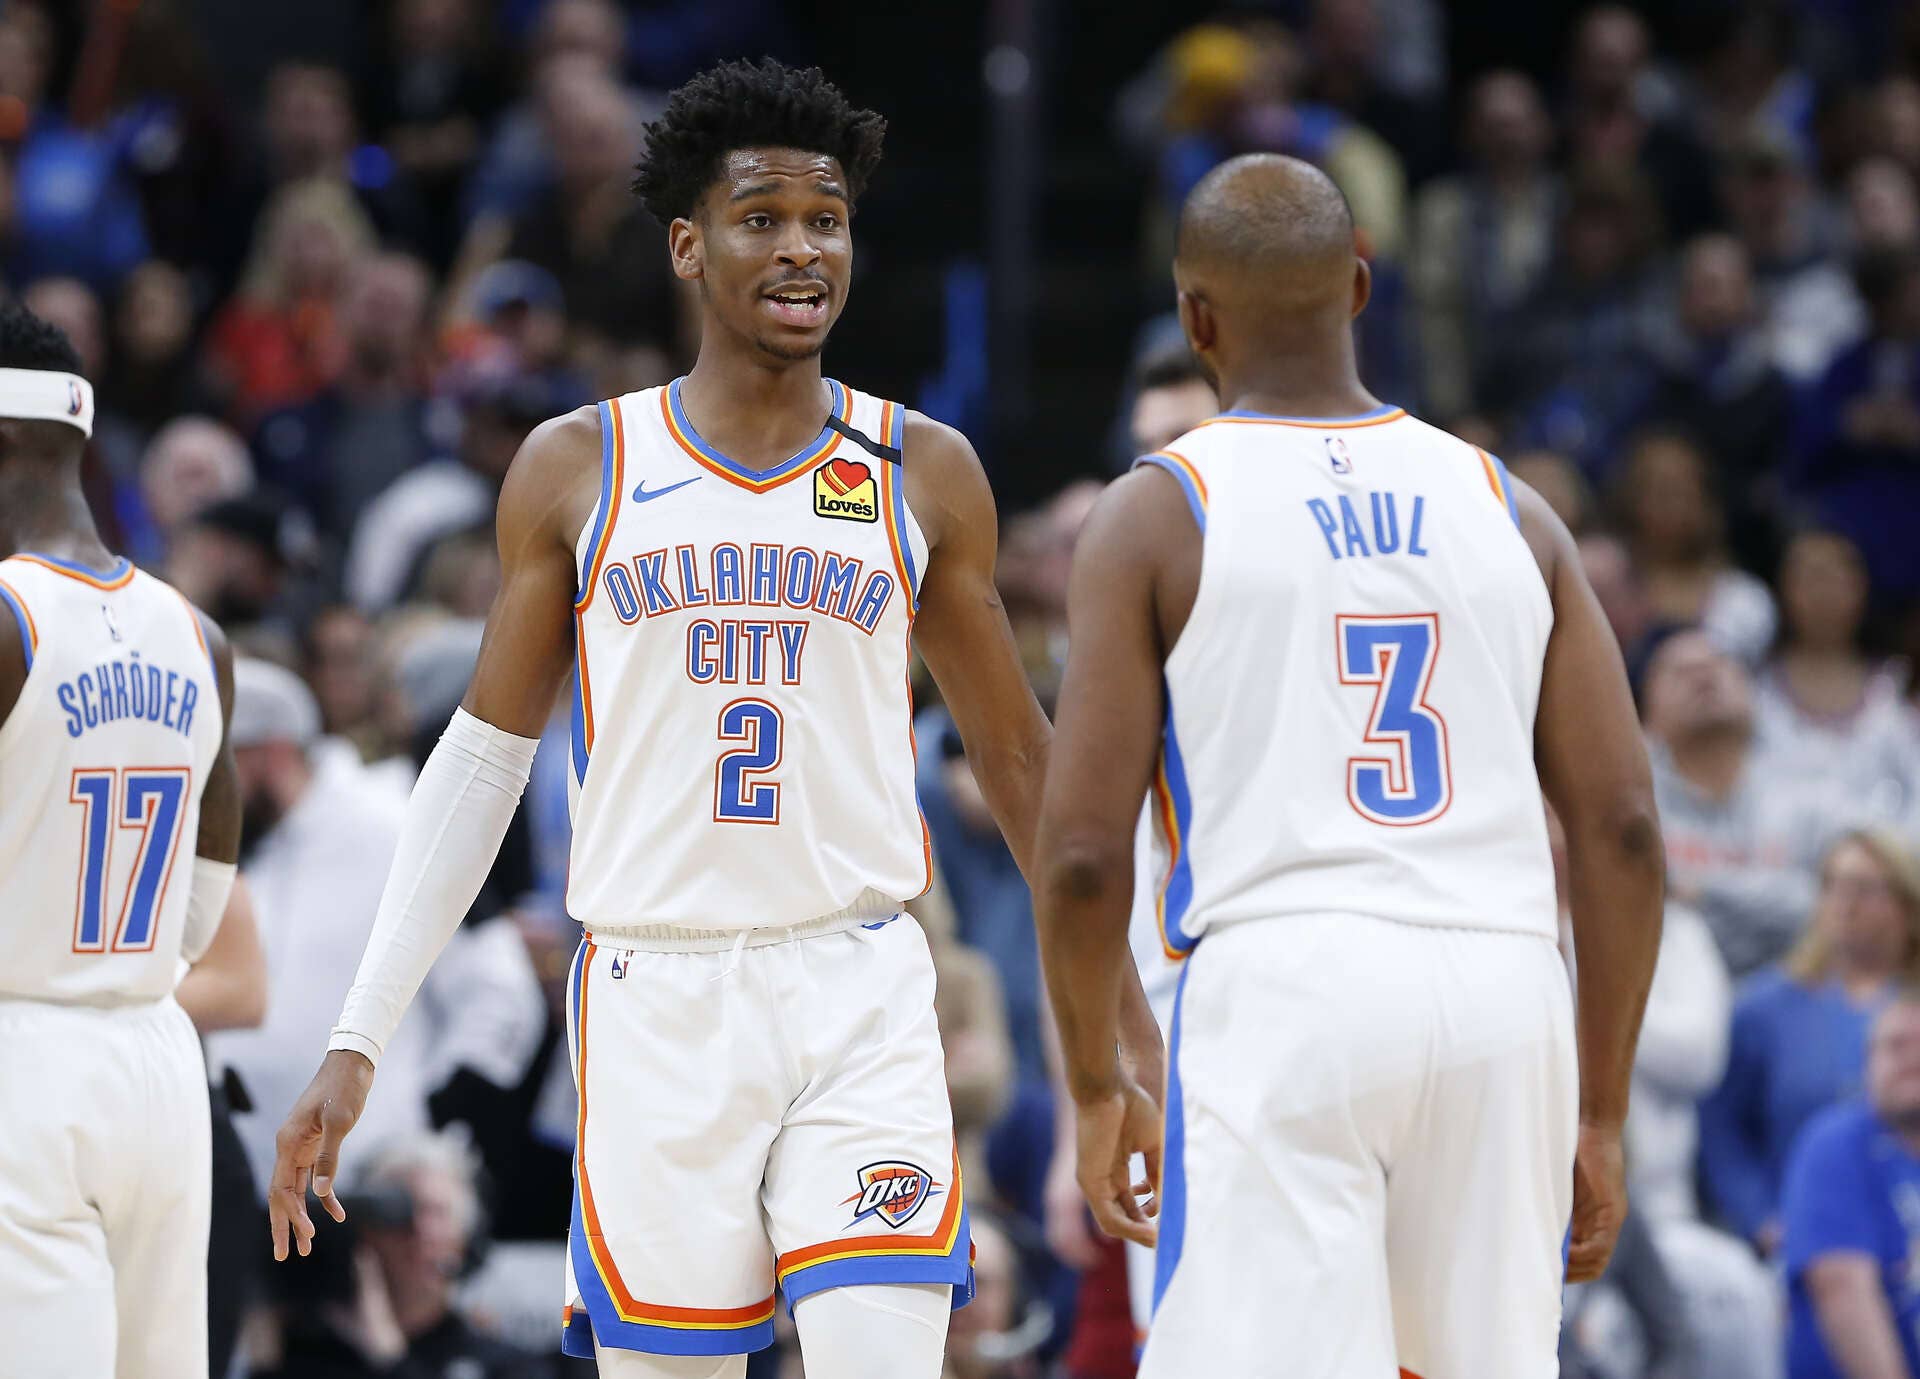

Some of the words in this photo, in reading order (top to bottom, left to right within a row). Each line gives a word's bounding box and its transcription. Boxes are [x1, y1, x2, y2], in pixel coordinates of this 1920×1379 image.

[1306, 491, 1428, 559] PAUL
[603, 542, 895, 636] OKLAHOMA
[57, 652, 199, 738] SCHRÖDER
[686, 618, 809, 685] CITY
[713, 697, 784, 826] 2
[1335, 612, 1452, 827] 3
[69, 767, 191, 954] 17
[856, 1175, 919, 1215] OKC
